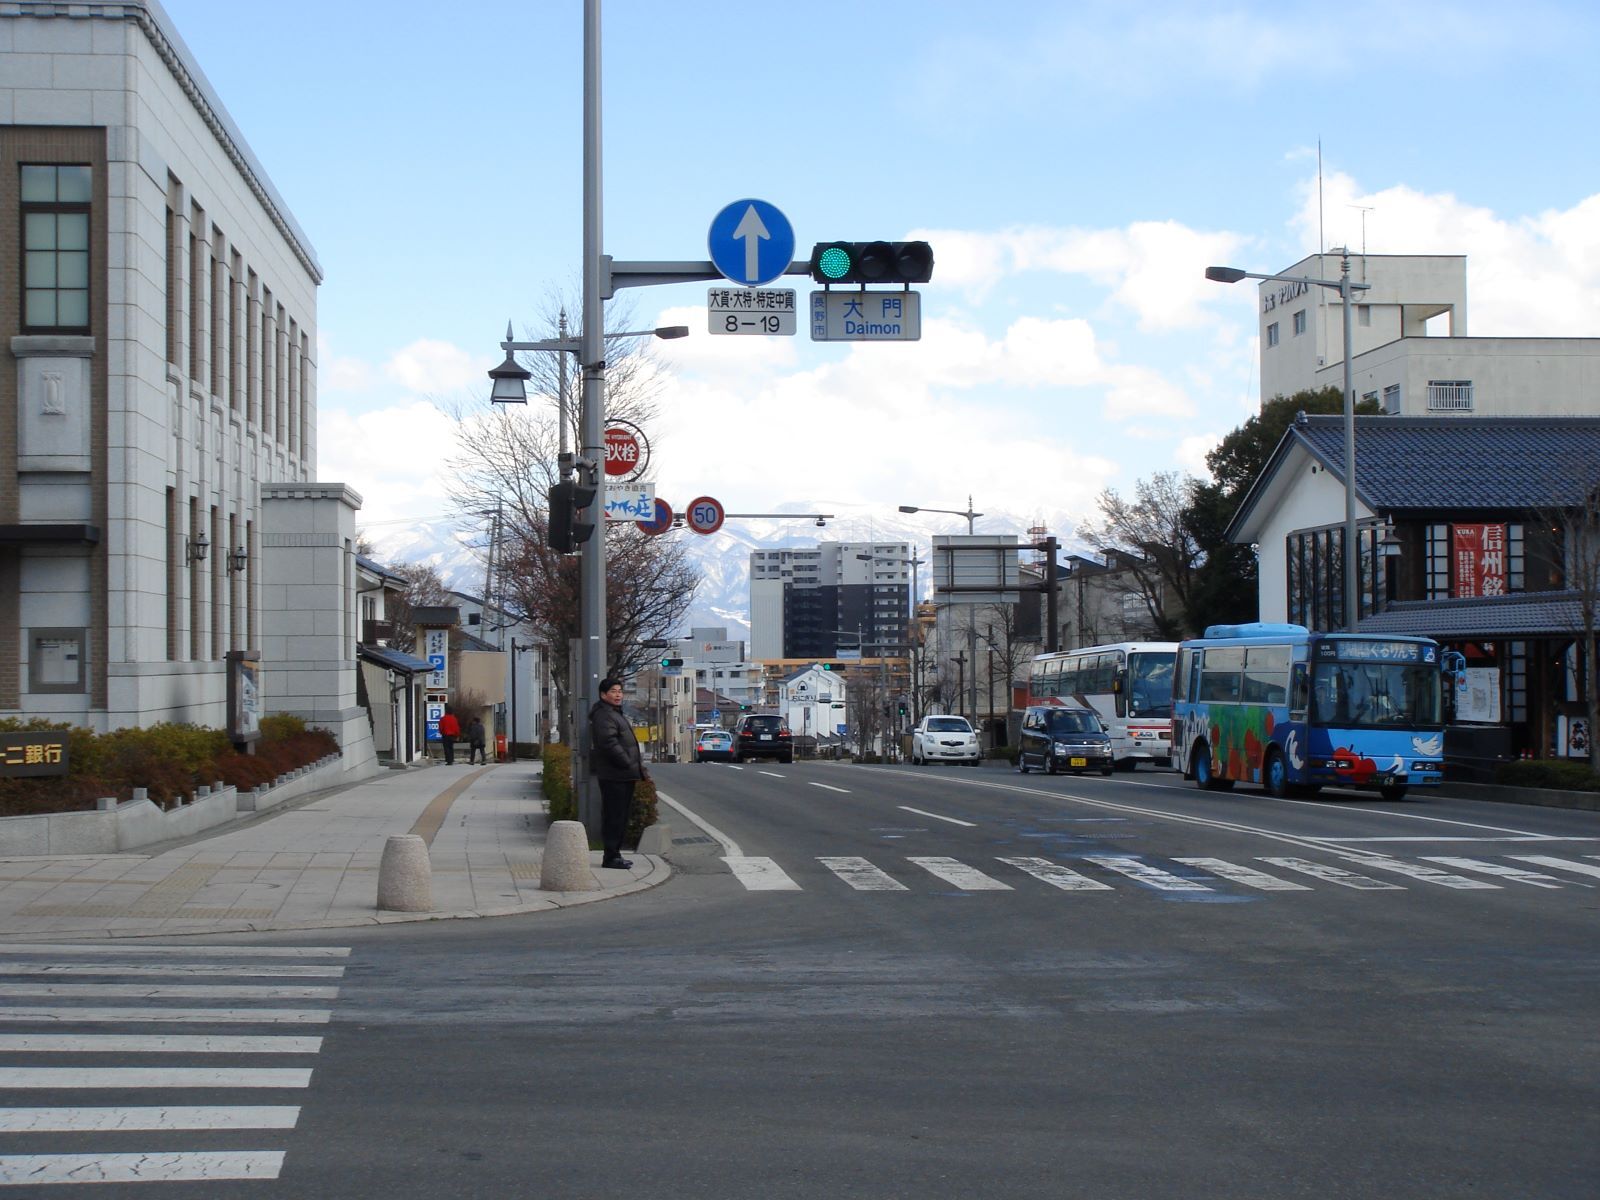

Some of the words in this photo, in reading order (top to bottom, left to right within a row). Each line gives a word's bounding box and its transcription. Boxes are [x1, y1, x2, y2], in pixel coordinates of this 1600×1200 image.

[814, 297, 825, 336] 長野市
[843, 298, 902, 319] 大門
[845, 320, 901, 335] Daimon
[694, 507, 716, 524] 50
[432, 710, 440, 719] P
[0, 743, 63, 764] 二銀行
